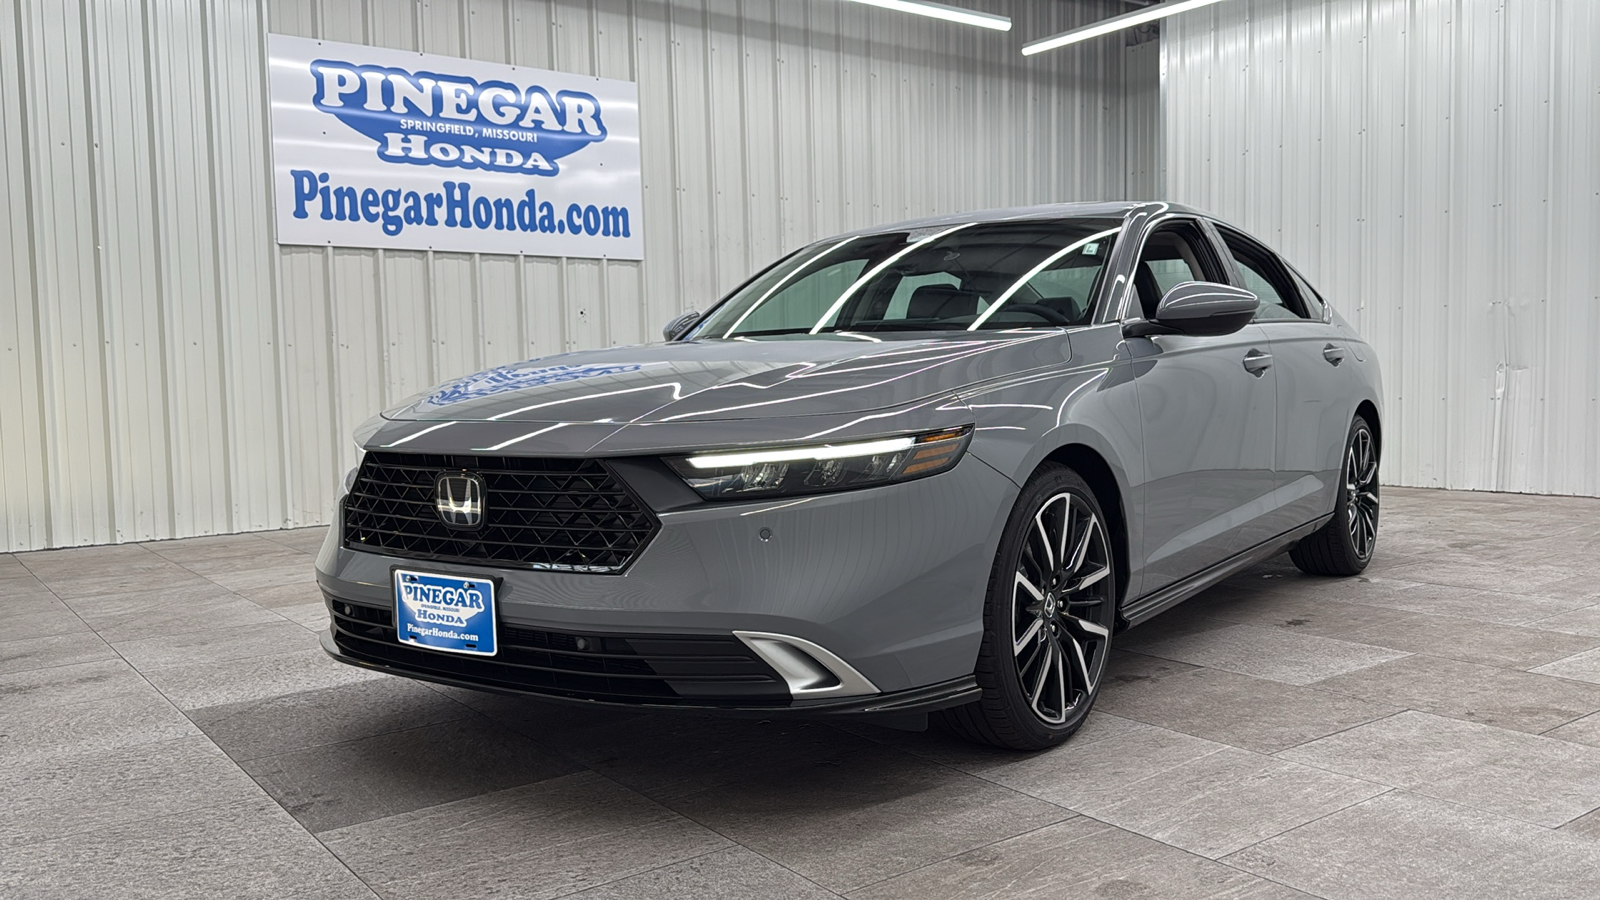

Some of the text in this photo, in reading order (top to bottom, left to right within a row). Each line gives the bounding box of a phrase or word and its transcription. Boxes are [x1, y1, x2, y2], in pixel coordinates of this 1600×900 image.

[317, 66, 601, 136] PINEGAR
[400, 118, 538, 143] SPRINGFIELD, MISSOURI
[383, 132, 554, 171] HONDA
[290, 169, 631, 238] PinegarHonda.com
[404, 585, 482, 609] PINEGAR
[417, 609, 465, 624] HONDA
[407, 623, 479, 641] PinegarHonda.com
